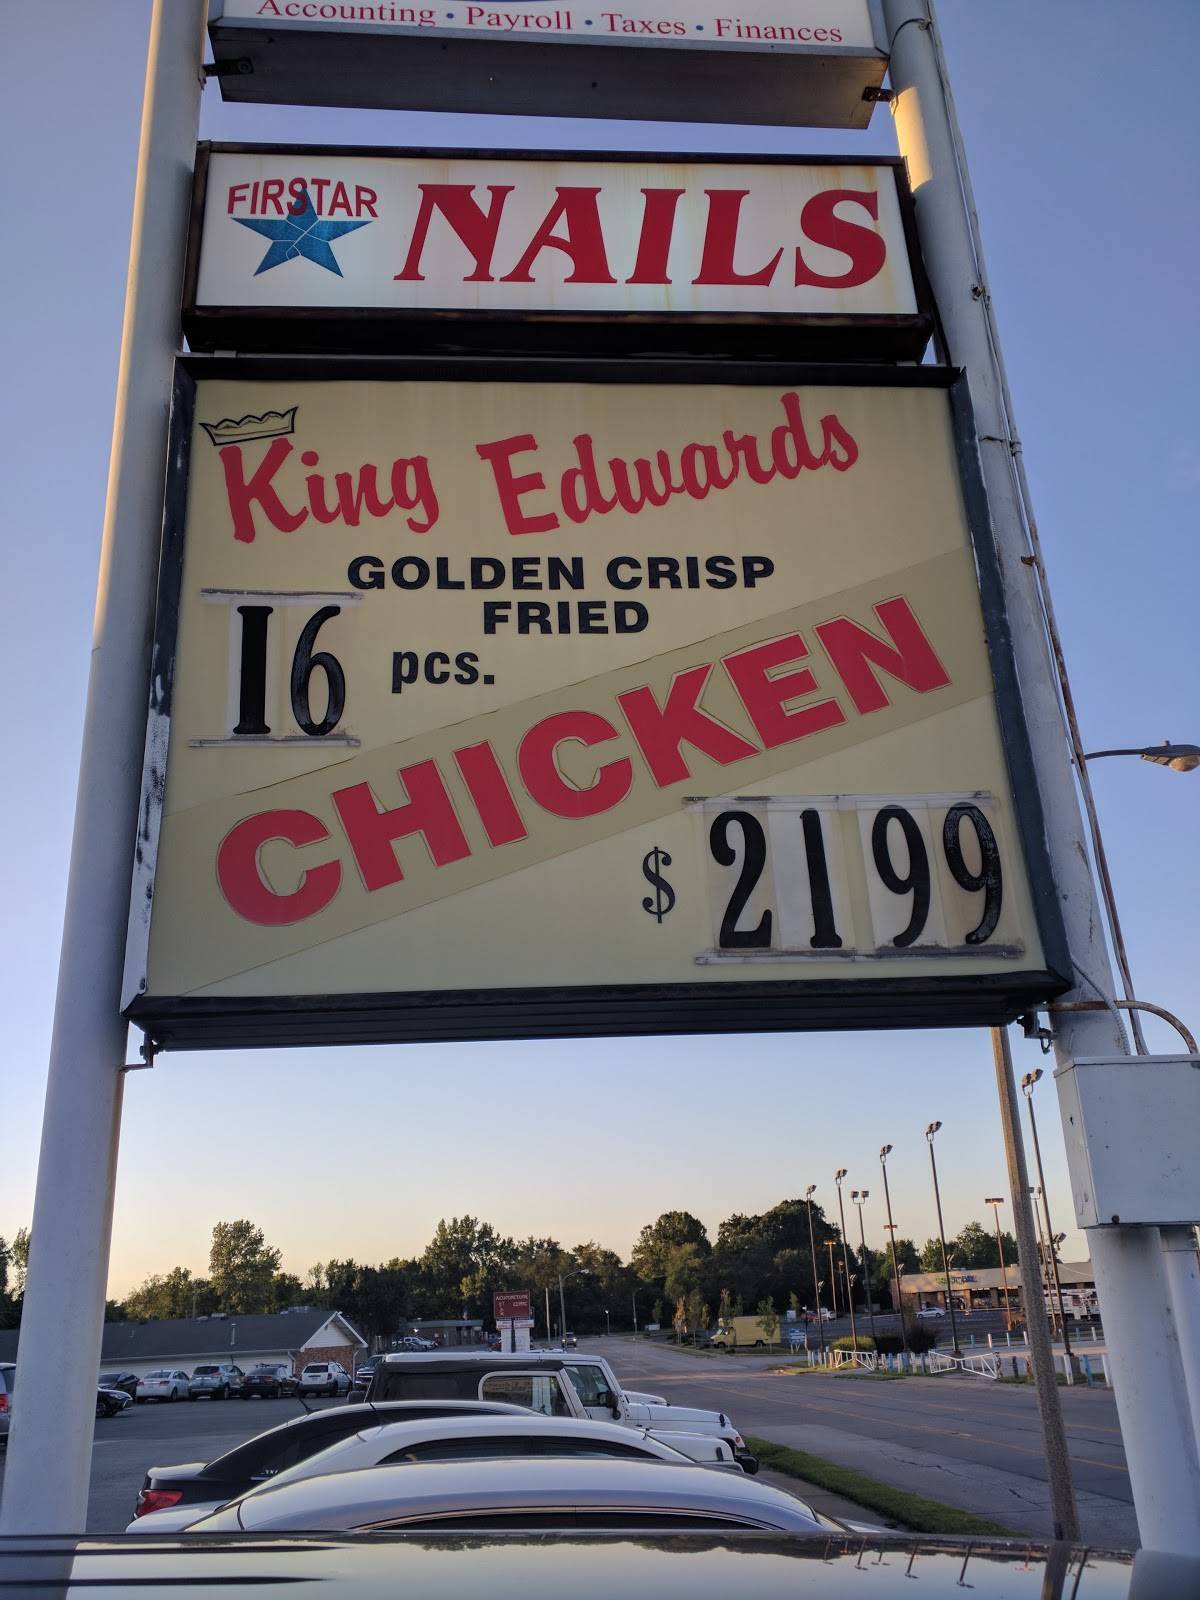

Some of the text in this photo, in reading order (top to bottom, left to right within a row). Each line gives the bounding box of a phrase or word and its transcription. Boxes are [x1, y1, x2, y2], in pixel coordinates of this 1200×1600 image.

[256, 0, 843, 43] Accounting Payroll Taxes Finances
[227, 177, 378, 219] FIRSTAR
[394, 183, 887, 289] NAILS
[219, 392, 860, 545] King Edwards
[347, 555, 776, 591] GOLDEN CRISP
[483, 601, 650, 635] FRIED
[391, 648, 496, 695] pcs.
[217, 595, 951, 927] CHICKEN
